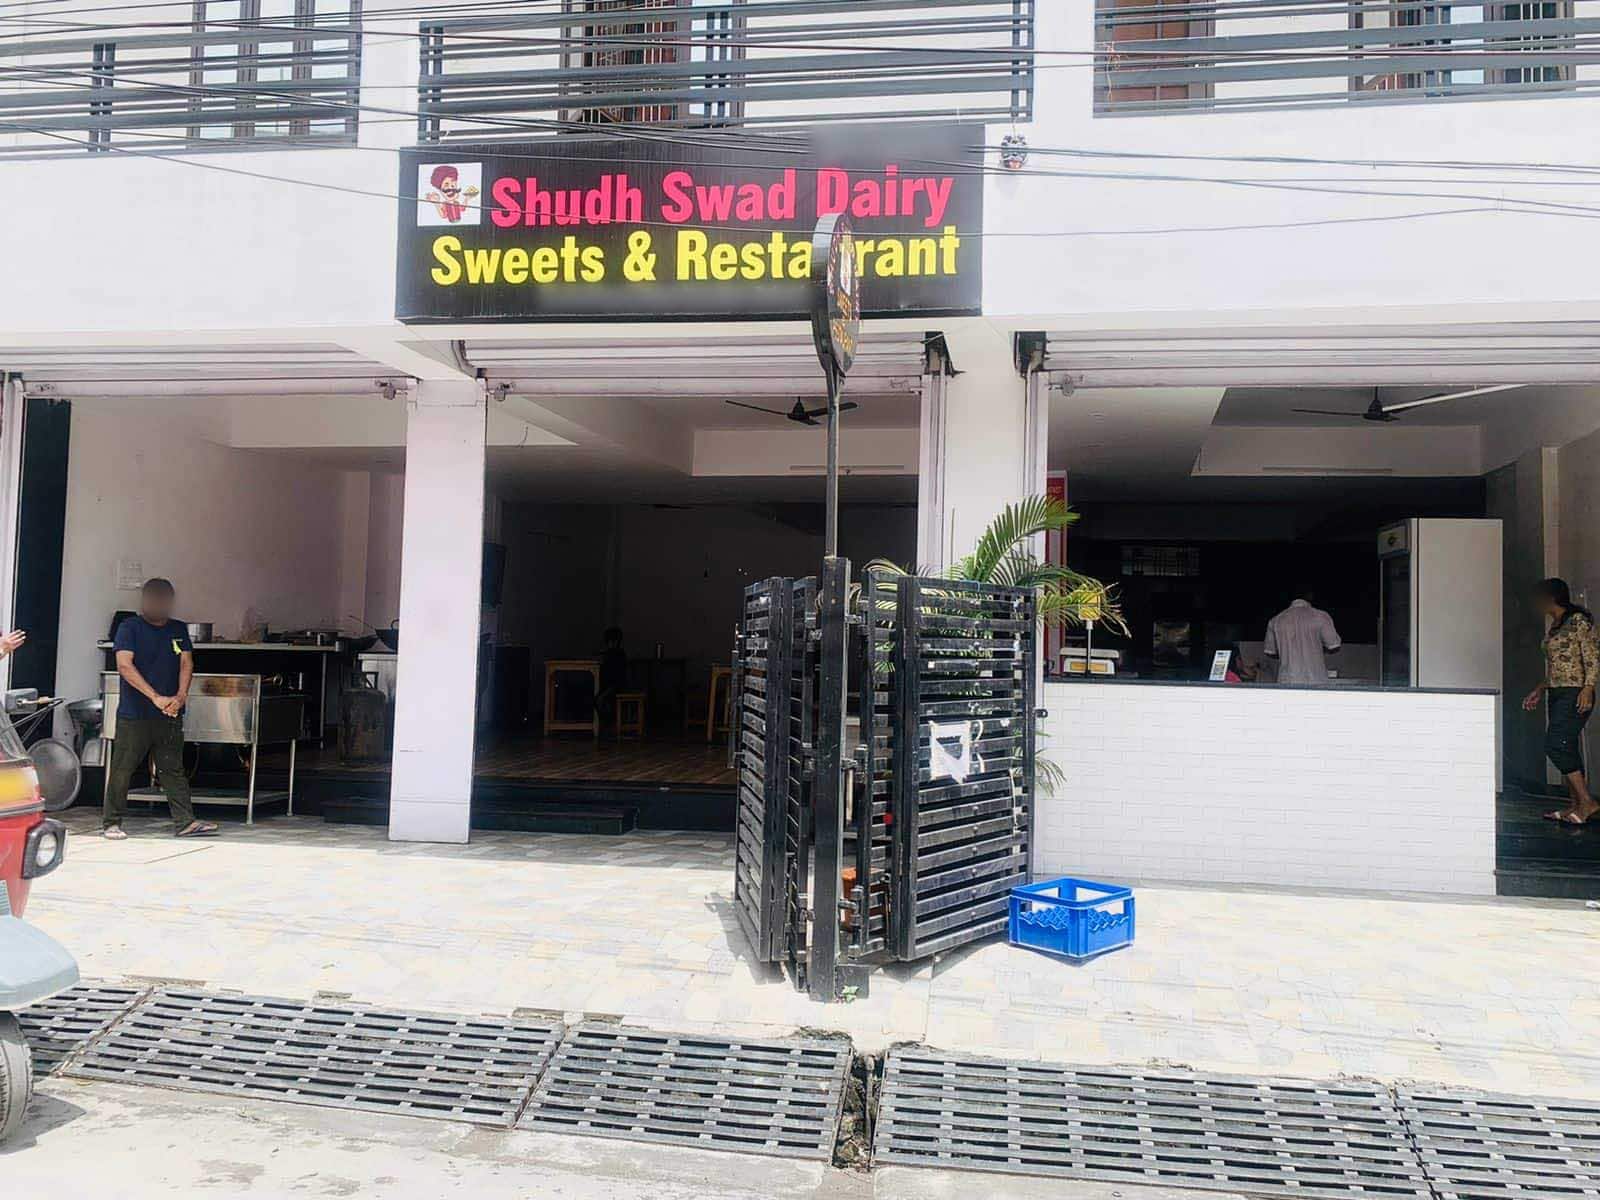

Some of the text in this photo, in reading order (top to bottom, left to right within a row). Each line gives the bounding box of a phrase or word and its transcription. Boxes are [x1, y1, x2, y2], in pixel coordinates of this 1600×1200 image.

[491, 166, 953, 227] Shudh Swad Dairy
[431, 236, 605, 286] Sweets
[622, 230, 657, 284] &
[674, 226, 960, 281] Restarant
